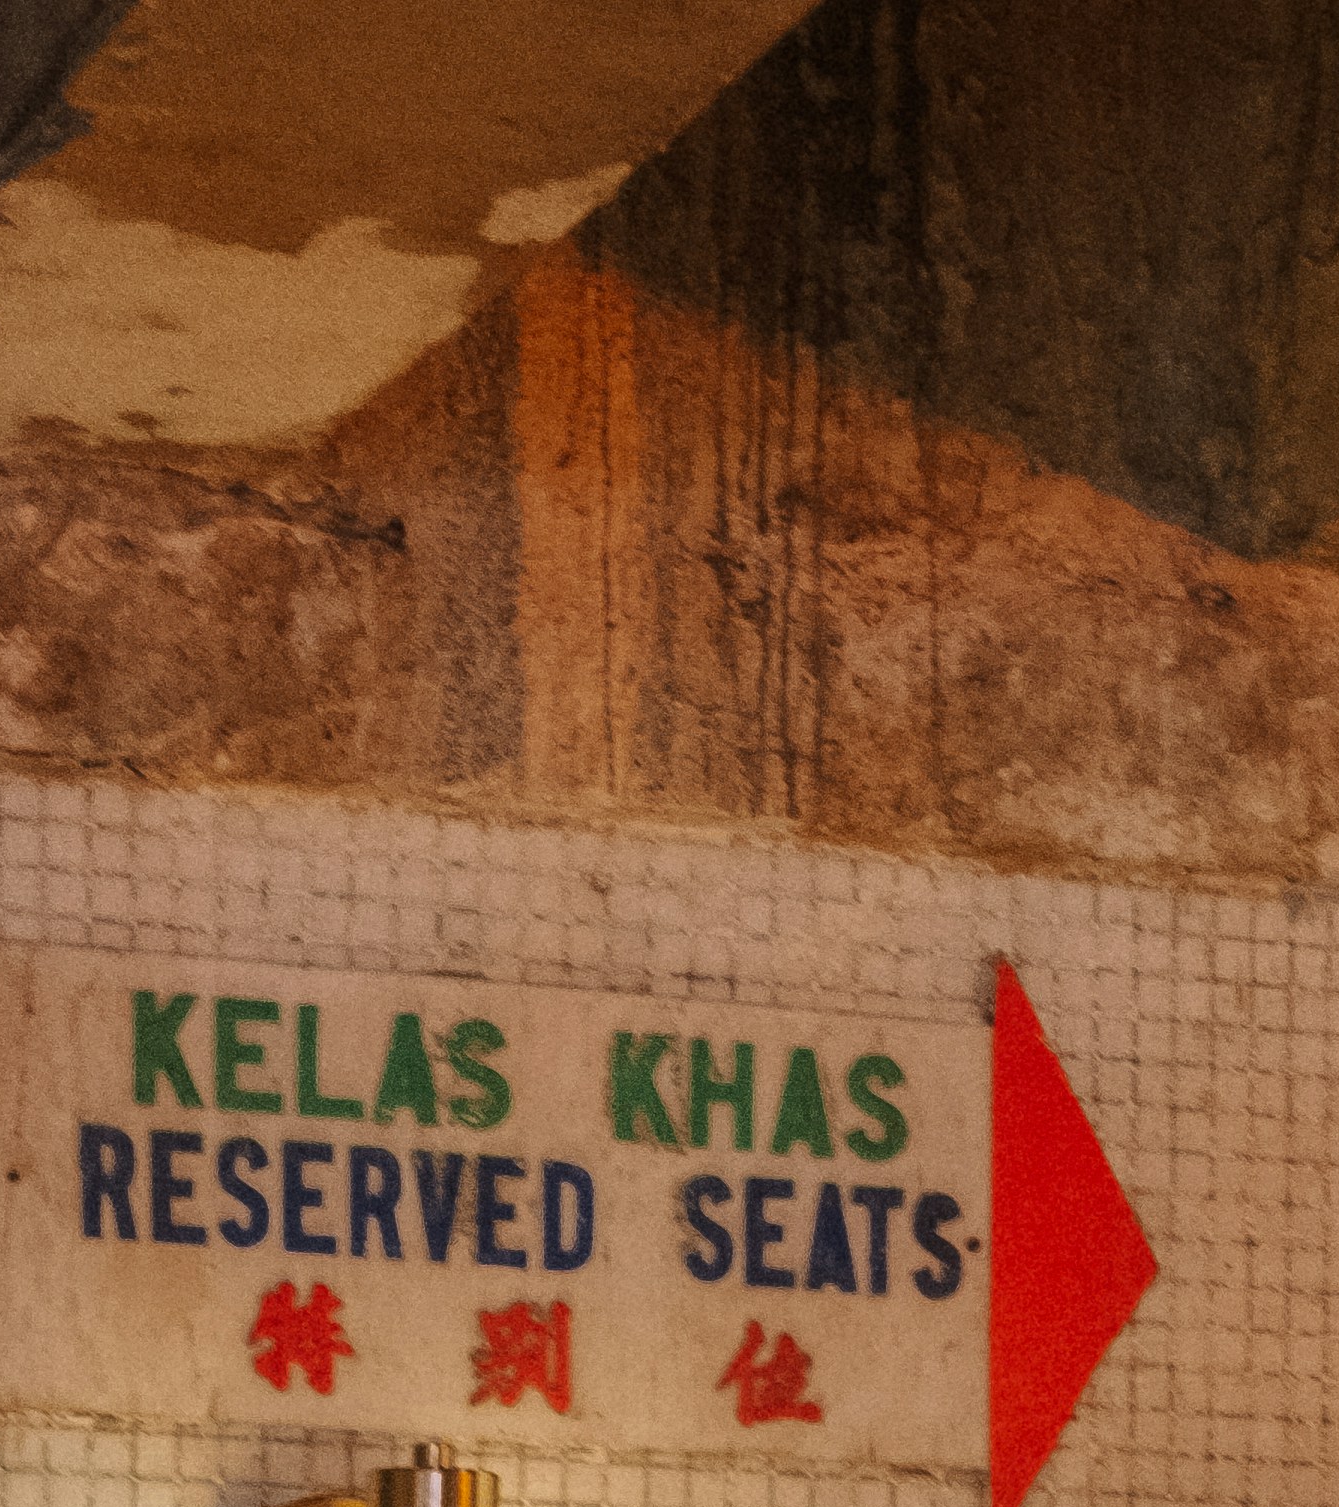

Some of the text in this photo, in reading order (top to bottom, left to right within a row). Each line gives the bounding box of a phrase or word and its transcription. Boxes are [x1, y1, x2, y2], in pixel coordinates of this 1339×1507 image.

[131, 991, 910, 1162] KELAS KHAS
[78, 1123, 963, 1300] RESERVED SEATS
